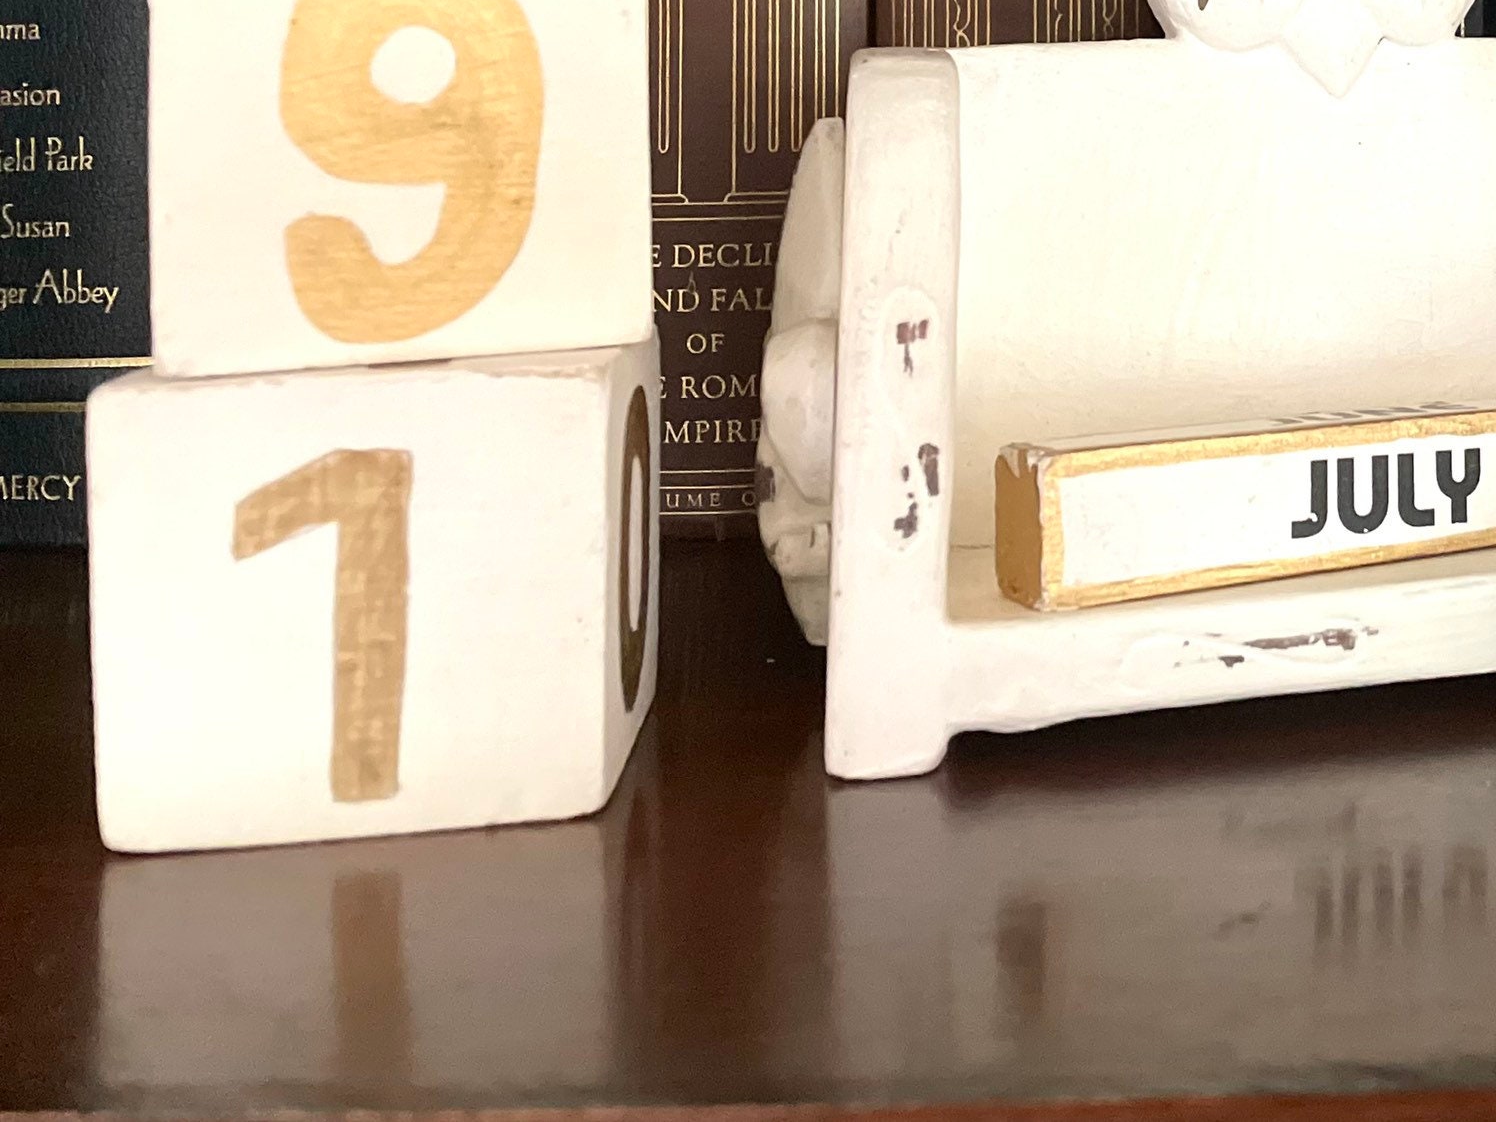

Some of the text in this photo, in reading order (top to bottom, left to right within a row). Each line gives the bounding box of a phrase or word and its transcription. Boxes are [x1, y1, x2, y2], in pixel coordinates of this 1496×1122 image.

[44, 135, 94, 172] Park
[0, 203, 70, 239] Susan
[671, 242, 773, 268] DECLI
[31, 268, 120, 314] Abbey
[651, 287, 773, 313] ND FAL
[686, 333, 725, 355] OF
[680, 374, 758, 399] ROM
[662, 419, 761, 444] MPIRE
[665, 492, 722, 509] UME
[1291, 448, 1482, 539] JULY
[232, 447, 414, 804] 1
